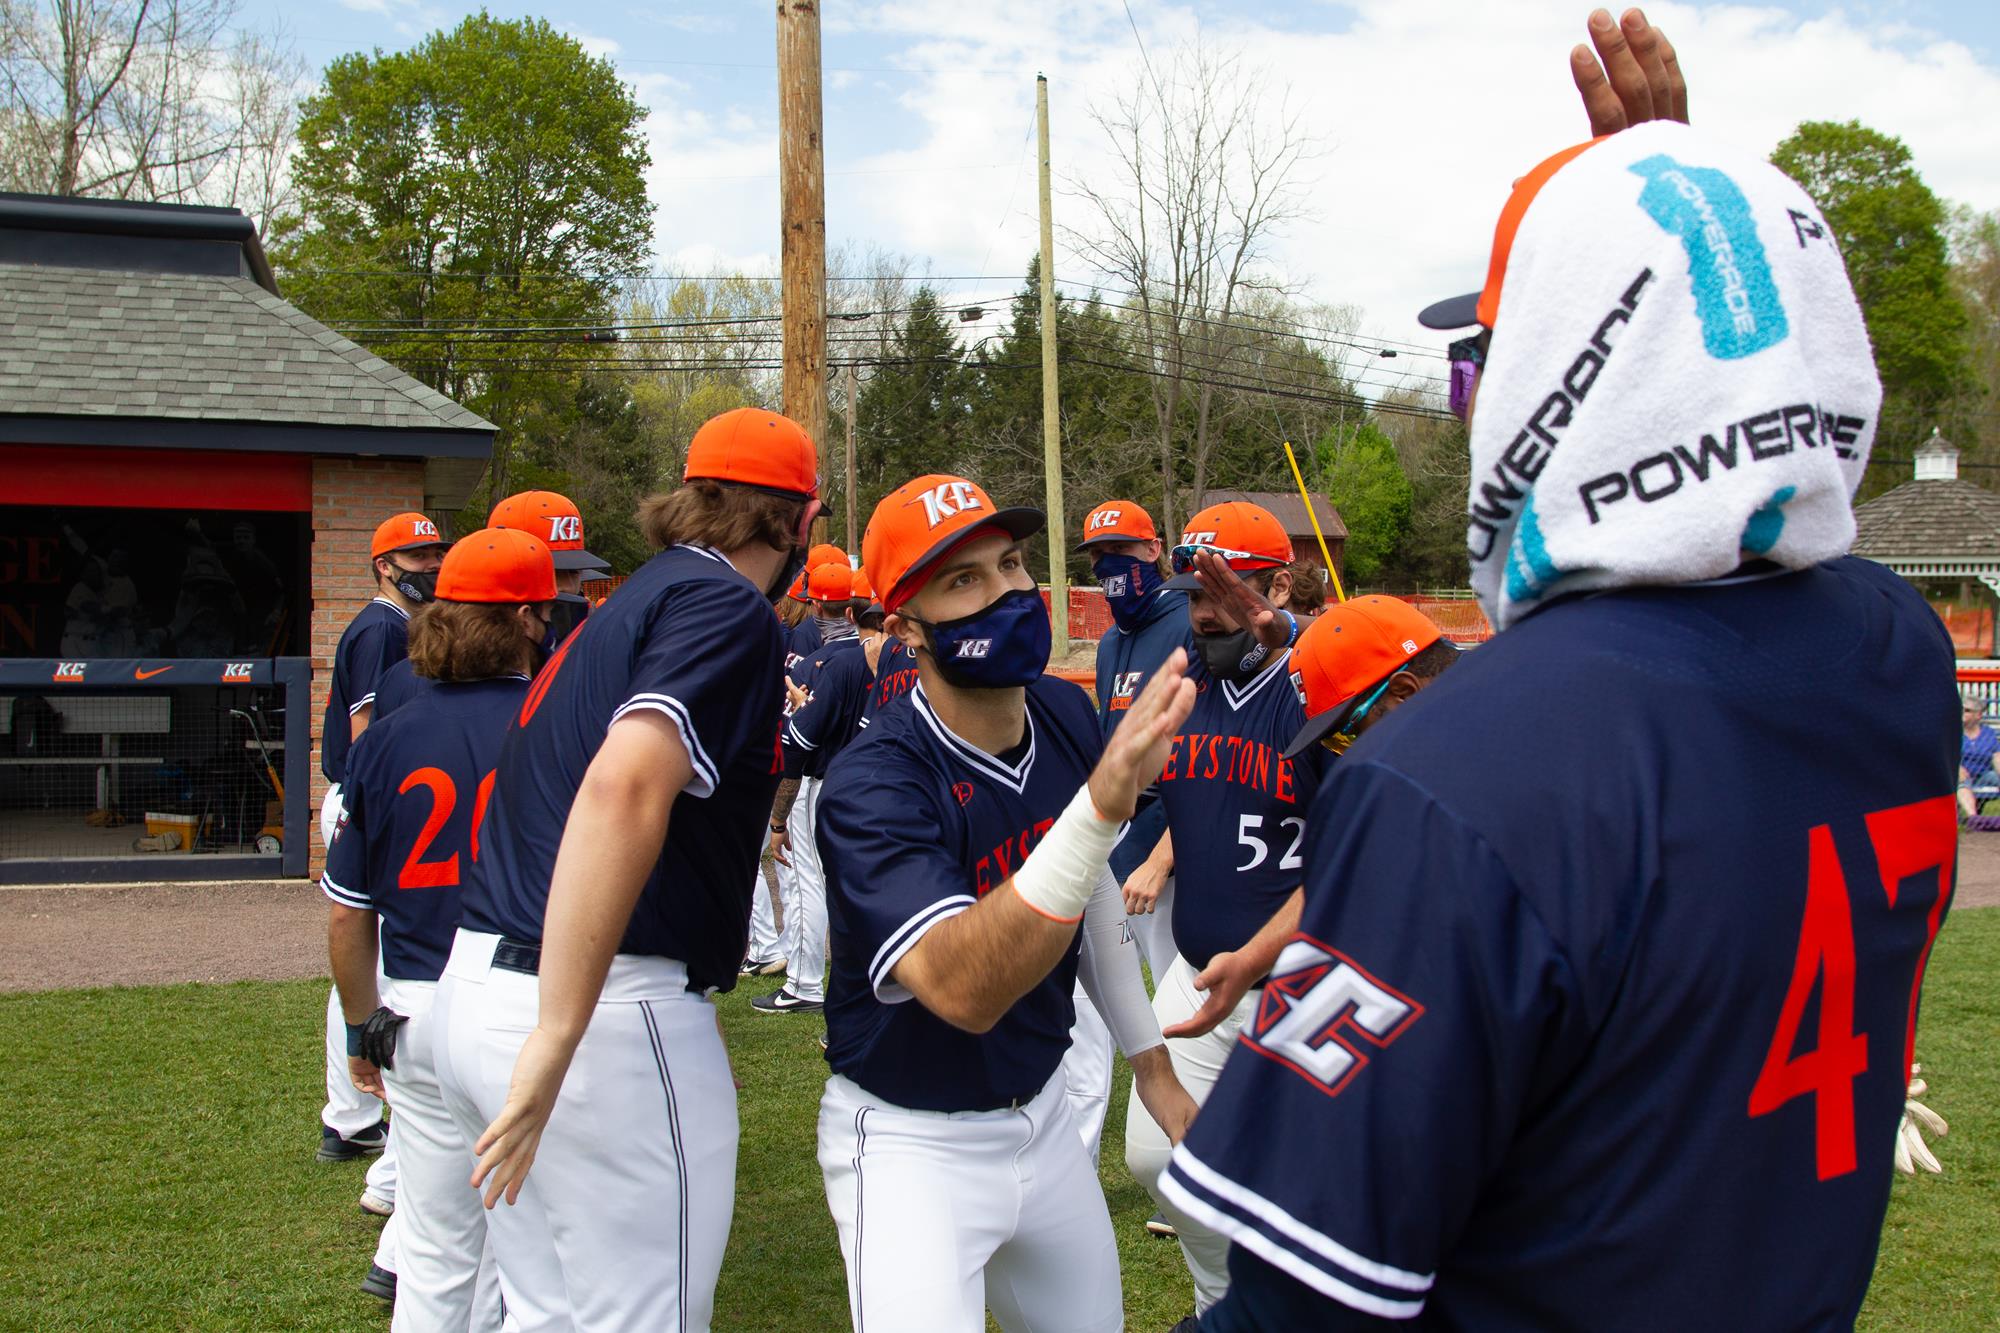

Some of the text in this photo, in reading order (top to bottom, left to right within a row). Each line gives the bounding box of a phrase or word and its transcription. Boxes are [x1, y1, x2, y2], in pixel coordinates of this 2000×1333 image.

[904, 481, 983, 531] KC
[413, 520, 436, 536] KC
[549, 516, 580, 541] KC
[1090, 510, 1122, 531] KC
[953, 638, 992, 658] KC
[55, 662, 87, 676] KC
[224, 663, 254, 677] KC
[877, 668, 919, 708] EYST
[1156, 734, 1296, 804] EYSTONE
[1236, 813, 1307, 872] 52
[1749, 795, 1957, 1183] 47
